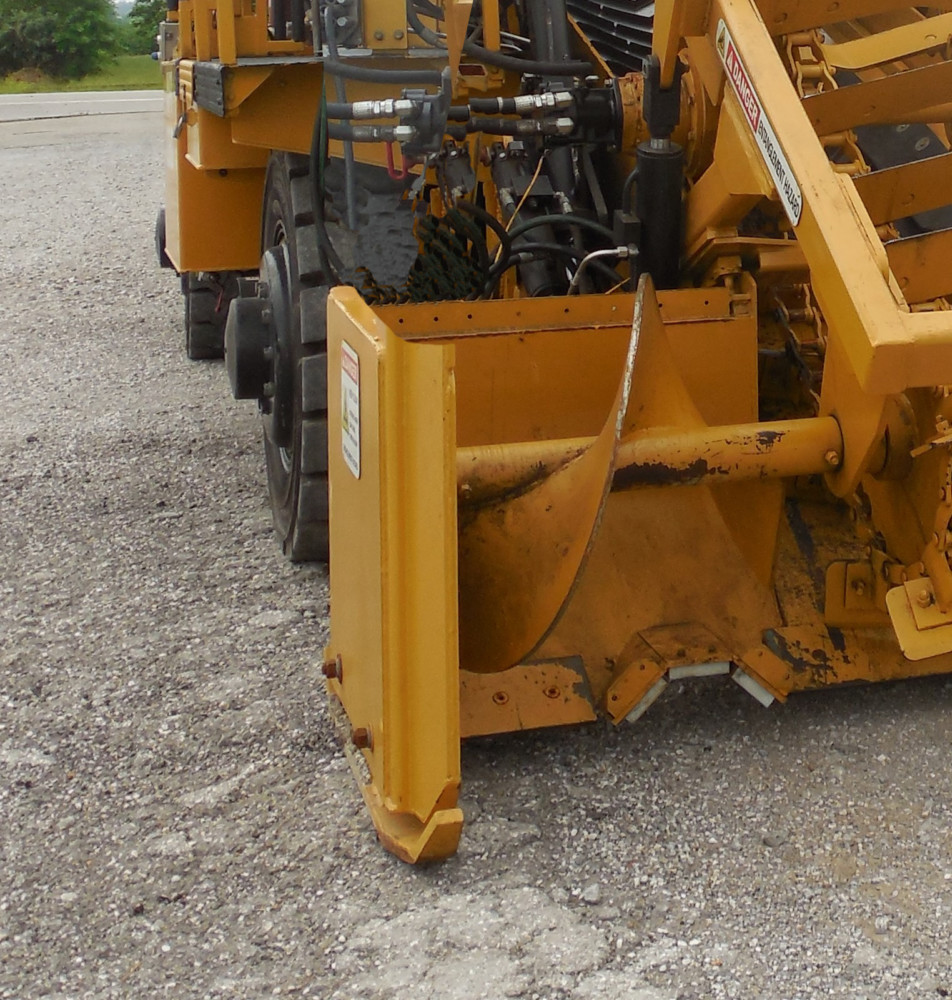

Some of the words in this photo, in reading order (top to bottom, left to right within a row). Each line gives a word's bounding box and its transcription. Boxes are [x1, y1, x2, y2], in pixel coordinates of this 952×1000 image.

[733, 62, 759, 122] DANGER
[758, 119, 786, 182] ENTANGLEMENT
[784, 178, 800, 218] HAZARD
